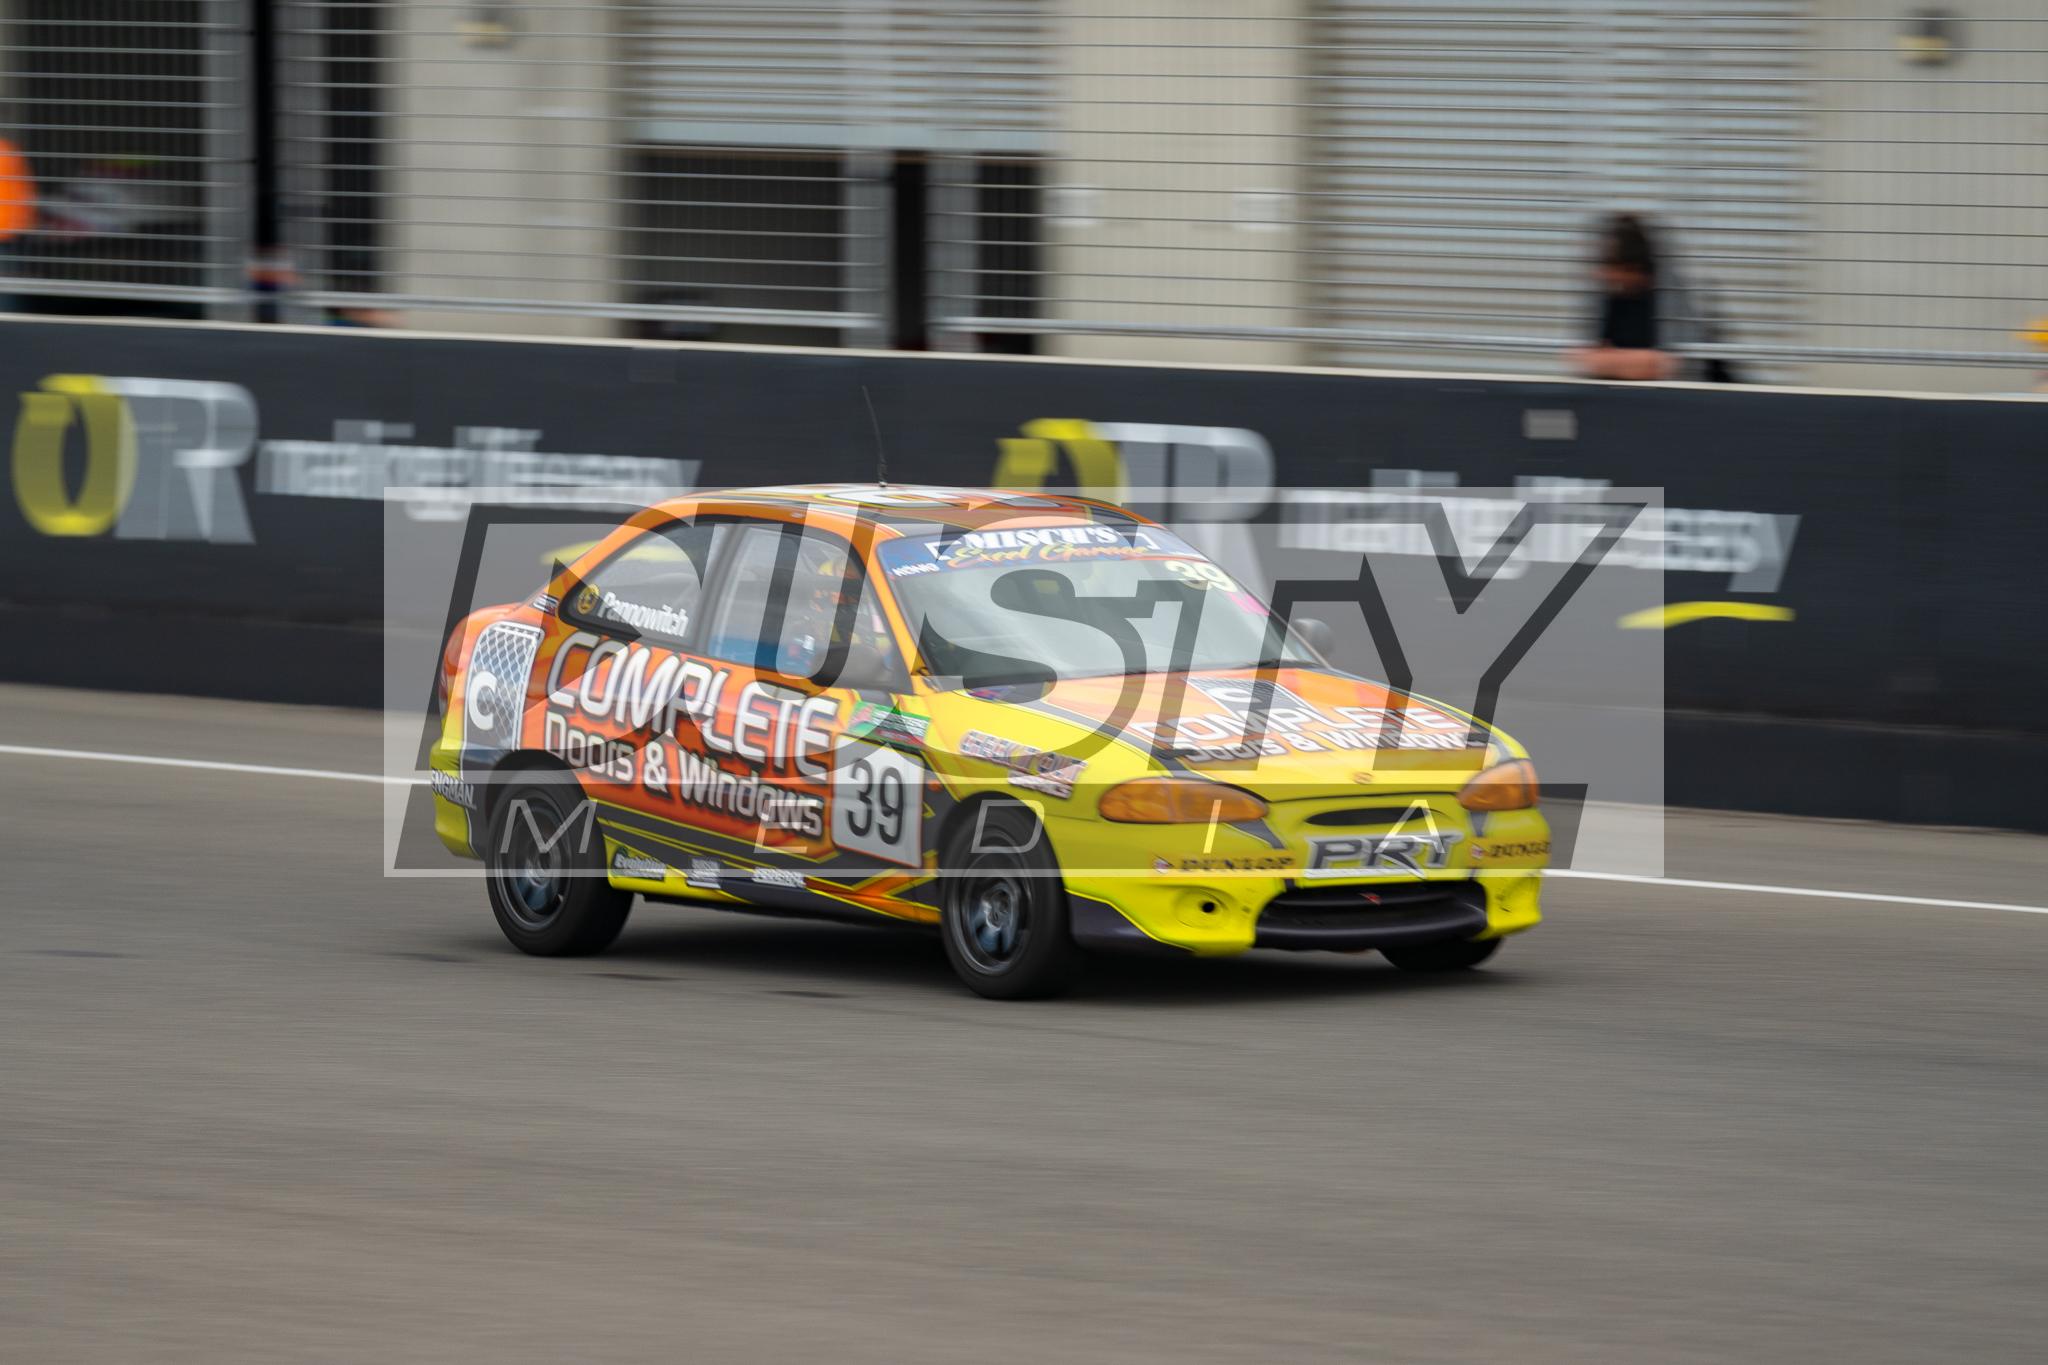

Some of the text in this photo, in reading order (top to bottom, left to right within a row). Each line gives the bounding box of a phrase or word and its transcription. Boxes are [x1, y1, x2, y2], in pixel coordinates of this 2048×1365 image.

[1165, 560, 1238, 592] 39
[546, 630, 838, 781] COMPLETE
[1130, 706, 1466, 742] COMPLETE
[1286, 731, 1325, 752] &
[545, 710, 824, 837] Doors & Windows
[846, 758, 904, 845] 39
